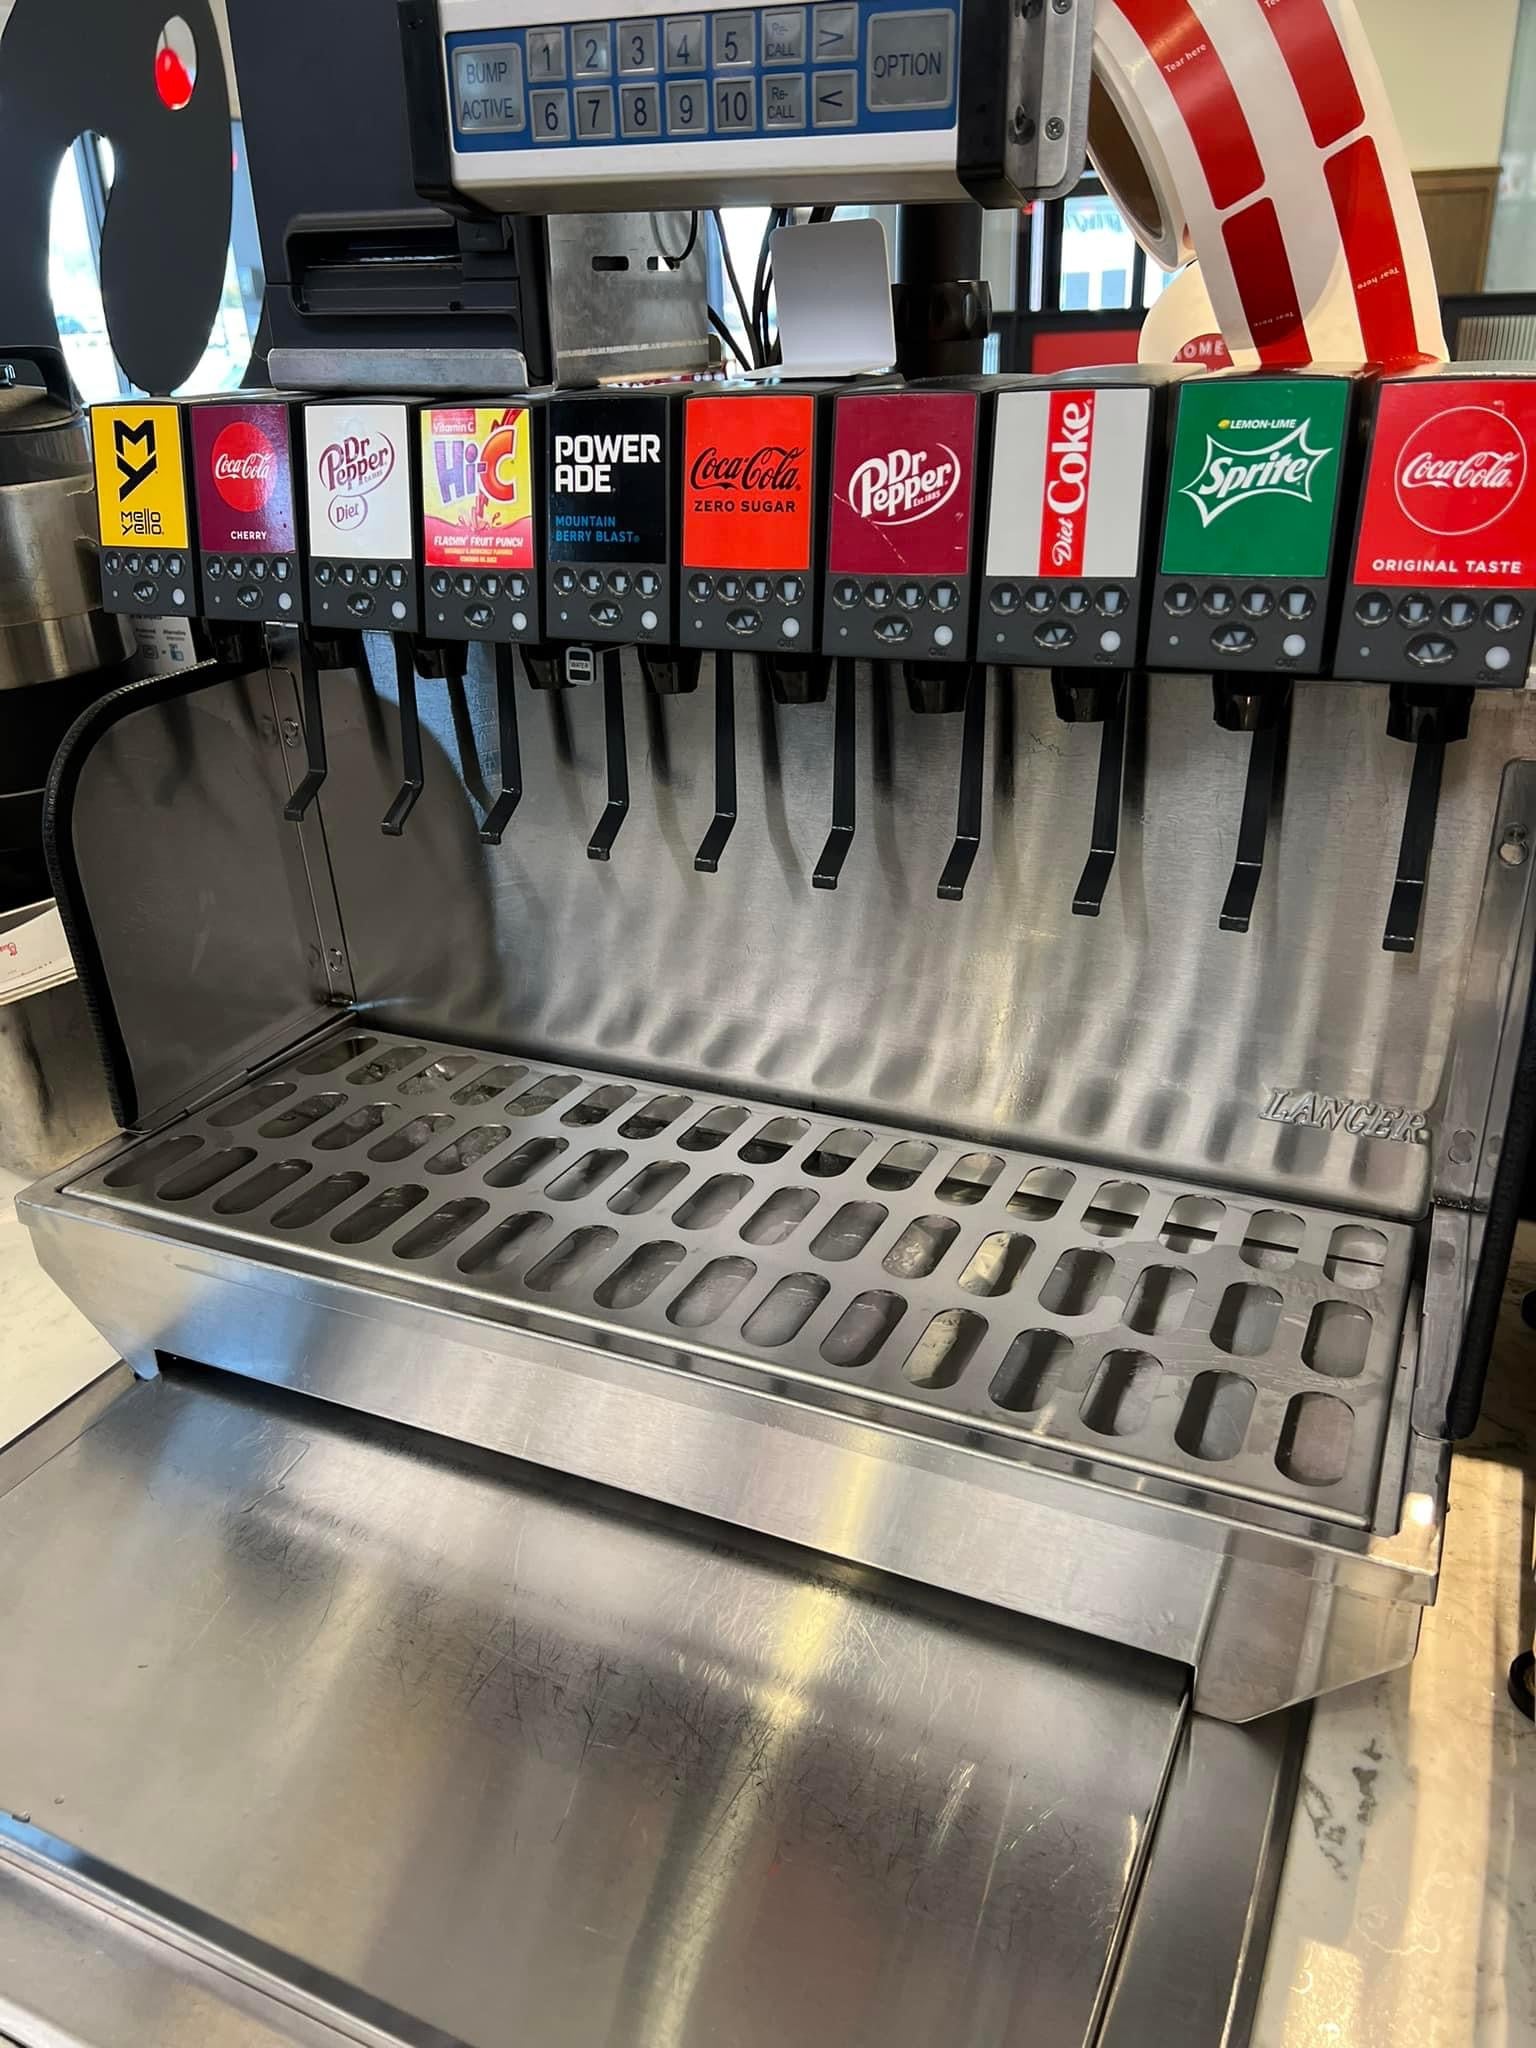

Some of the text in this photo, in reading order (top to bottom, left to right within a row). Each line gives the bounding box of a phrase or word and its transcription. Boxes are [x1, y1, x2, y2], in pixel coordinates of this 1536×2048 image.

[542, 44, 551, 72] 1
[585, 39, 598, 68] 2
[631, 35, 645, 65] 3
[676, 34, 690, 65] 4
[724, 31, 738, 62] 5
[766, 43, 795, 57] CALL
[1163, 43, 1207, 74] Tear here
[466, 62, 507, 84] BUMP
[873, 52, 942, 78] OPTION
[720, 91, 747, 122] 10
[772, 87, 788, 100] Re-
[462, 98, 515, 120] ACTIVE
[544, 102, 559, 131] 6
[588, 100, 600, 129] 7
[634, 97, 647, 126] 8
[680, 95, 693, 124] 9
[767, 105, 795, 119] CALL
[1230, 419, 1296, 430] LEMON-LIME
[343, 436, 370, 464] Dr
[554, 434, 661, 463] POWER
[214, 452, 275, 479] Coca-Cola
[319, 444, 389, 492] Pepper
[433, 426, 517, 504] Hi-C
[554, 465, 612, 493] ADE
[690, 447, 805, 491] Coca-Cola
[888, 449, 927, 486] Dr
[1199, 452, 1309, 499] Sprite
[1402, 451, 1520, 489] Coca-Cola
[849, 458, 952, 518] Pepper
[1047, 401, 1092, 568] Diet Coke
[336, 503, 360, 523] Diet
[555, 516, 616, 528] MOUNTAIN
[694, 501, 796, 514] ZERO SUGAR
[230, 529, 267, 541] CHERRY
[470, 536, 495, 547] FRUIT
[496, 537, 524, 548] PUNCH
[555, 531, 634, 543] BERRY BLAST
[1372, 559, 1521, 574] ORIGINAL TASTE
[1259, 1088, 1426, 1144] LANCER
